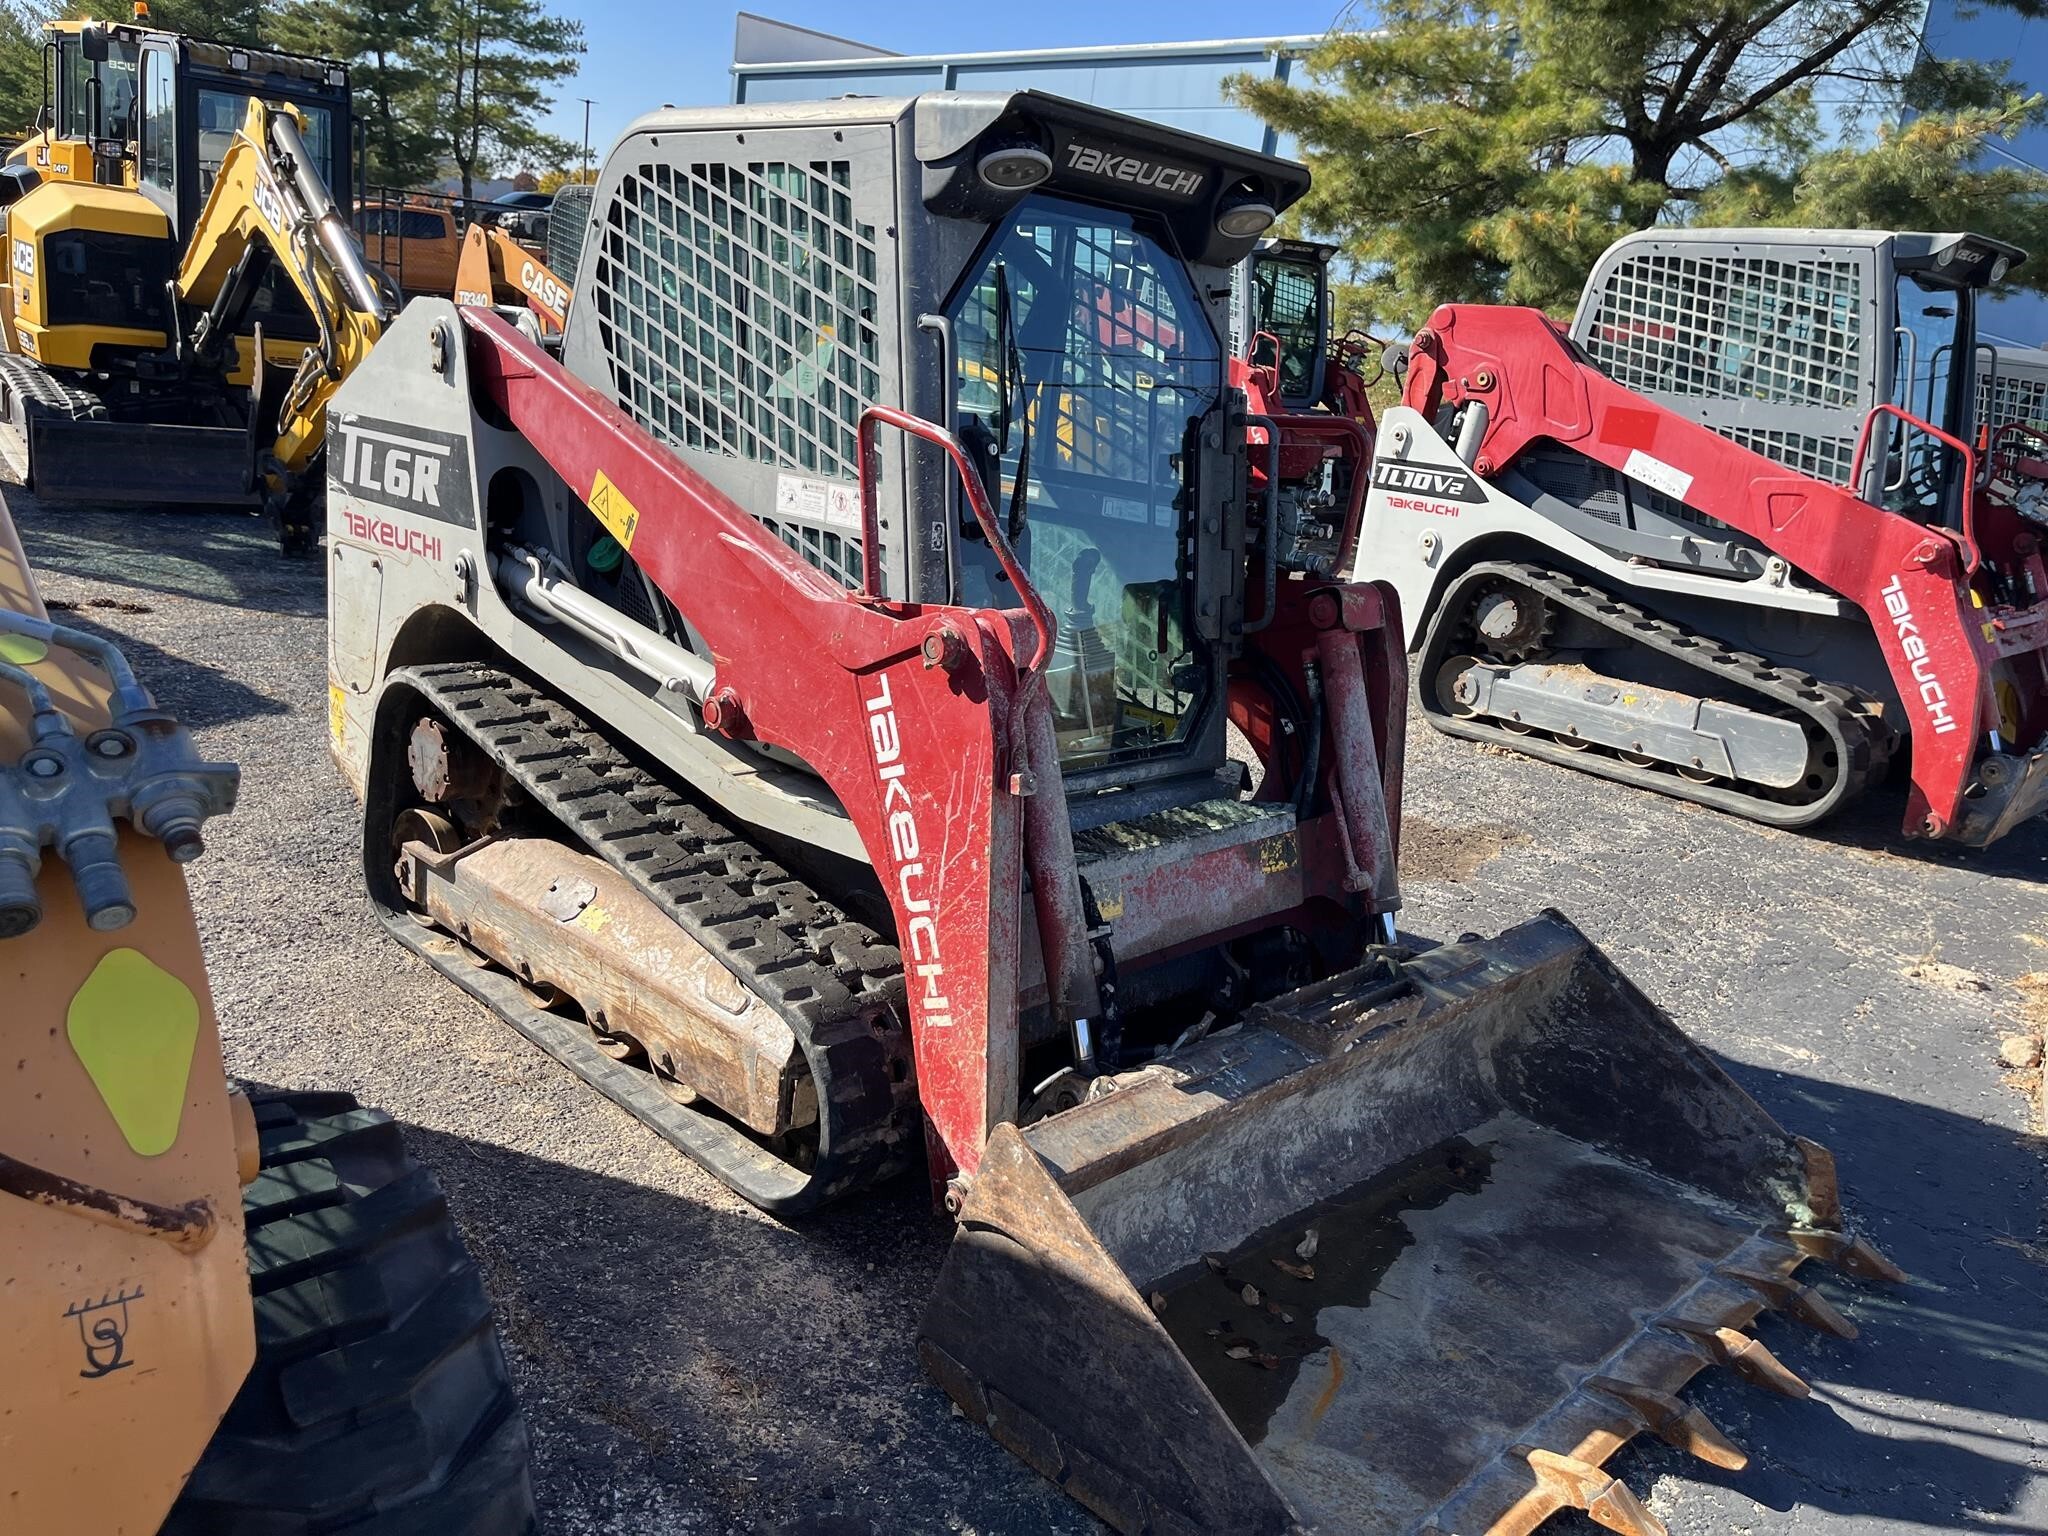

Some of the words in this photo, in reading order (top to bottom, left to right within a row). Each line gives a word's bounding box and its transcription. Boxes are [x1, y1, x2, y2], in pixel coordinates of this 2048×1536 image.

[1067, 144, 1204, 195] TAKEUCHI
[254, 180, 281, 234] JCB
[13, 240, 34, 276] JCB
[521, 261, 569, 317] CASE
[338, 422, 451, 508] TL6R
[1386, 496, 1460, 517] TAKEUCHI
[342, 511, 442, 562] TAKEUCHI
[1880, 574, 1958, 734] TAKEUCHI
[865, 672, 953, 1028] TAKEUCHI
